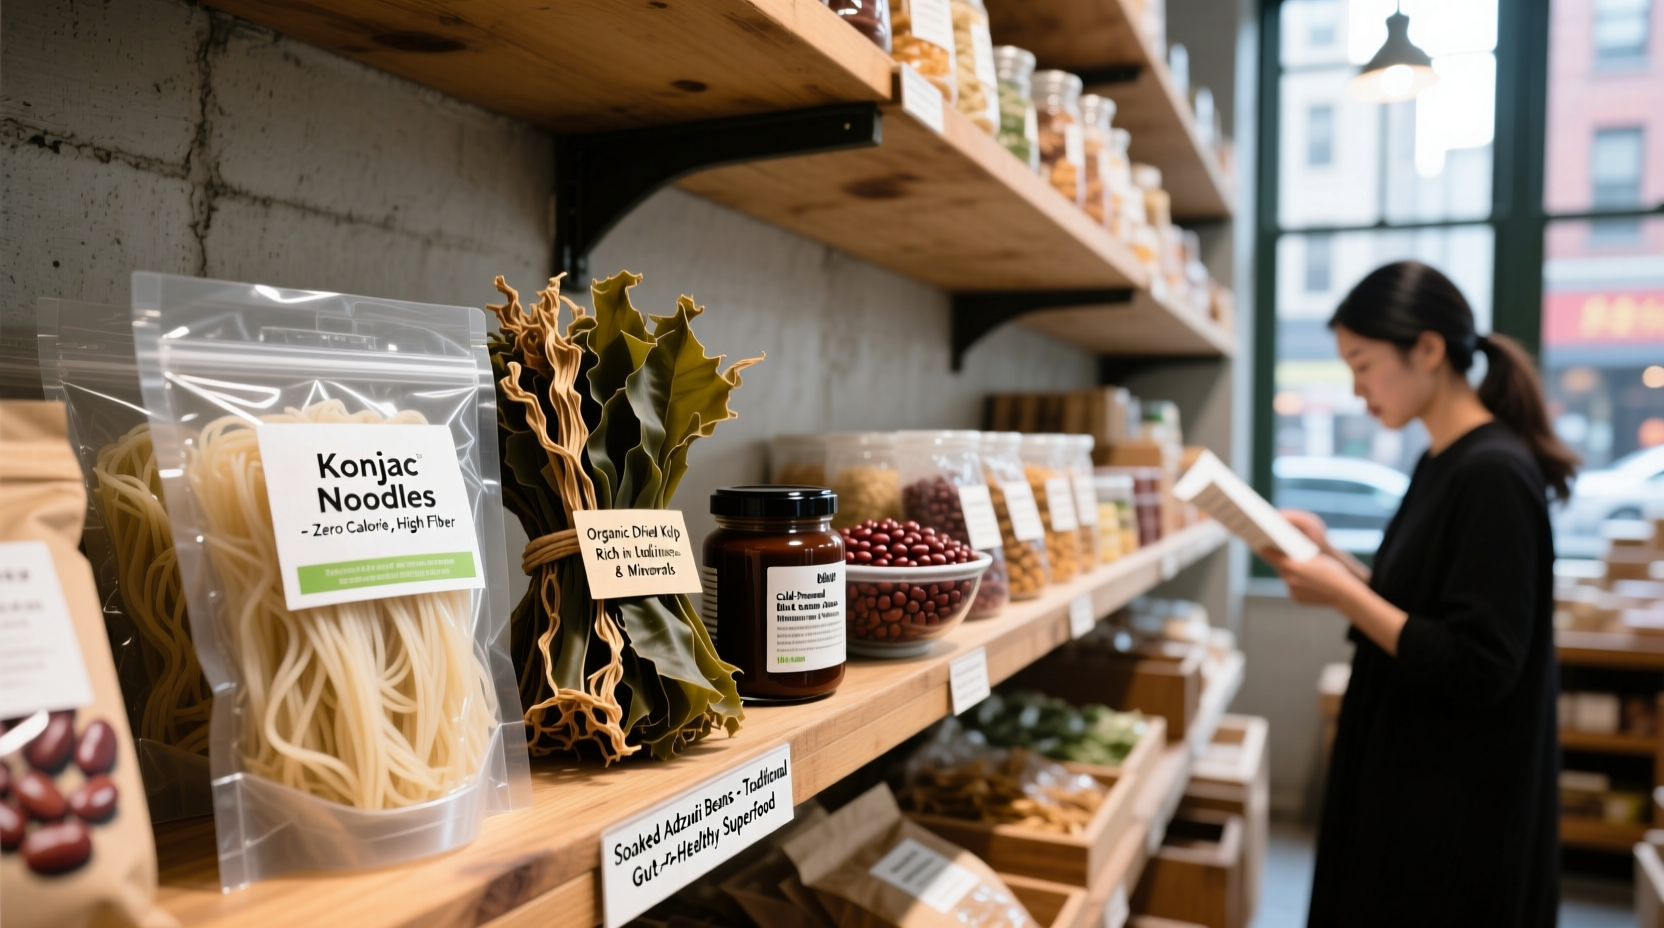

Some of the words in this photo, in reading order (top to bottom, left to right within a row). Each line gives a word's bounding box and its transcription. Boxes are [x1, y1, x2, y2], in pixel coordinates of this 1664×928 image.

[317, 451, 418, 486] Konjac
[317, 484, 436, 513] Noodles
[312, 523, 343, 537] Zero
[397, 513, 424, 534] High
[587, 525, 629, 544] Organic
[596, 547, 619, 561] Rich
[723, 791, 776, 836] Superfood
[614, 823, 661, 866] Soaked
